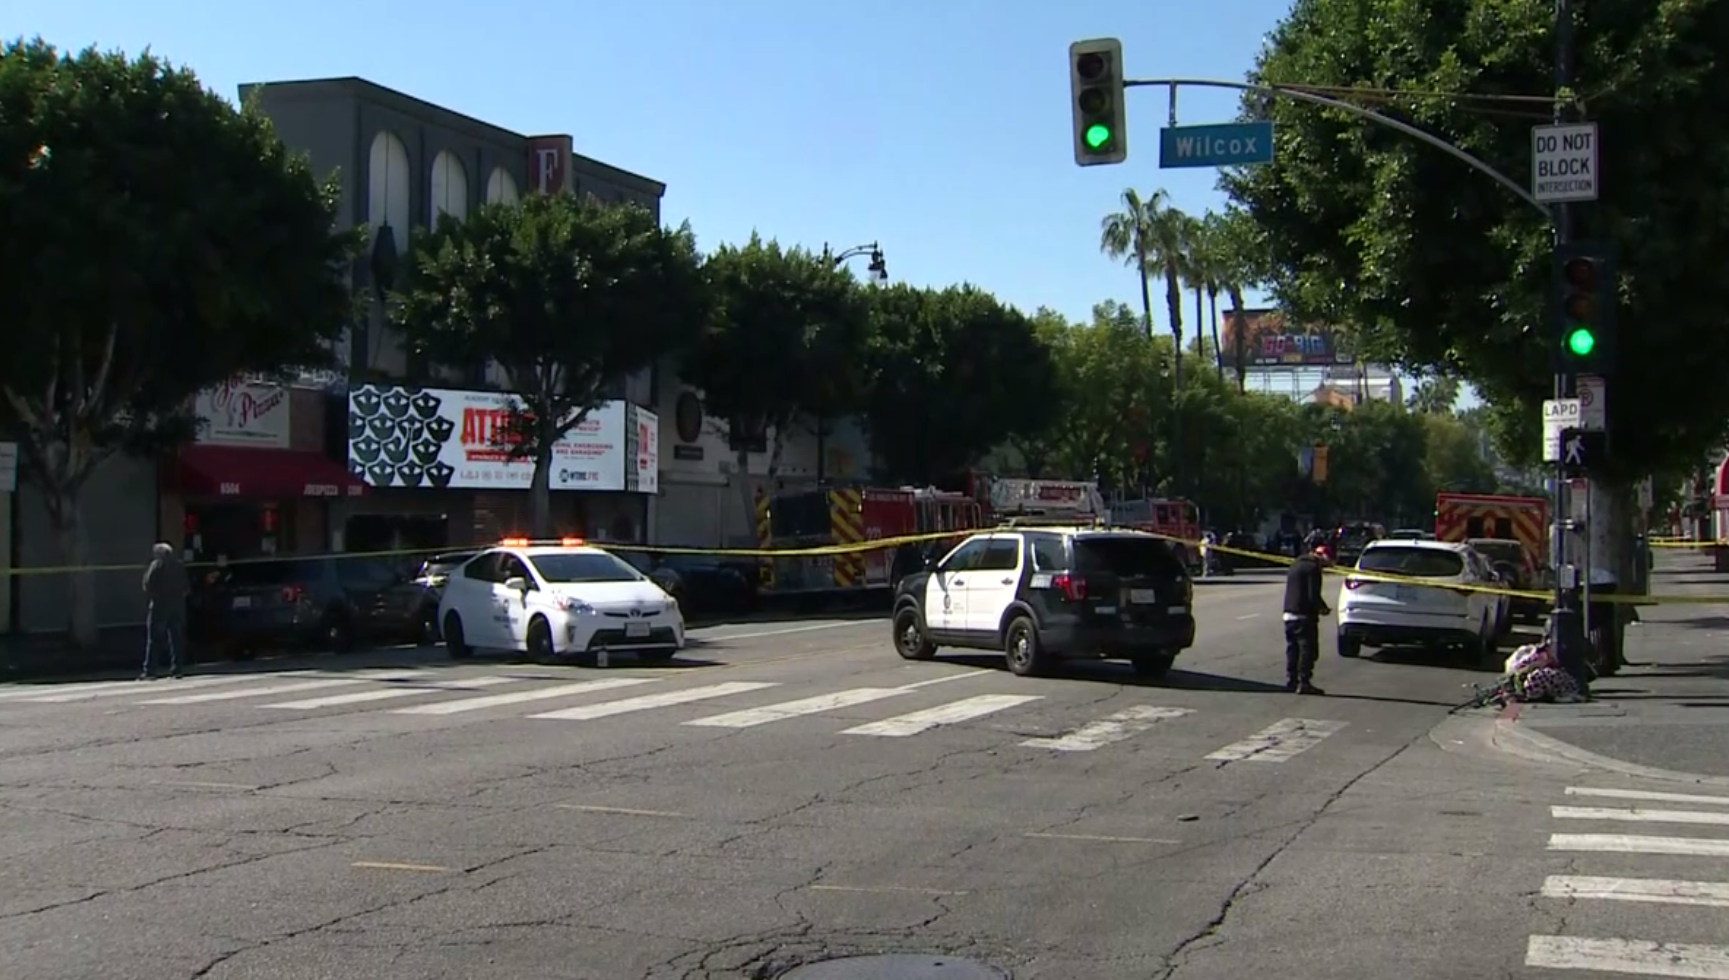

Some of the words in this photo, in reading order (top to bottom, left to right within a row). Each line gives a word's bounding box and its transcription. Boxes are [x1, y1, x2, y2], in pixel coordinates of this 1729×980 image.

[1176, 136, 1257, 157] Wilcox
[1537, 135, 1557, 153] DO
[1563, 133, 1592, 151] NOT
[536, 149, 558, 196] F
[1538, 158, 1590, 177] BLOCK
[1538, 180, 1592, 193] INTERSECTION
[1544, 404, 1578, 416] LAPD
